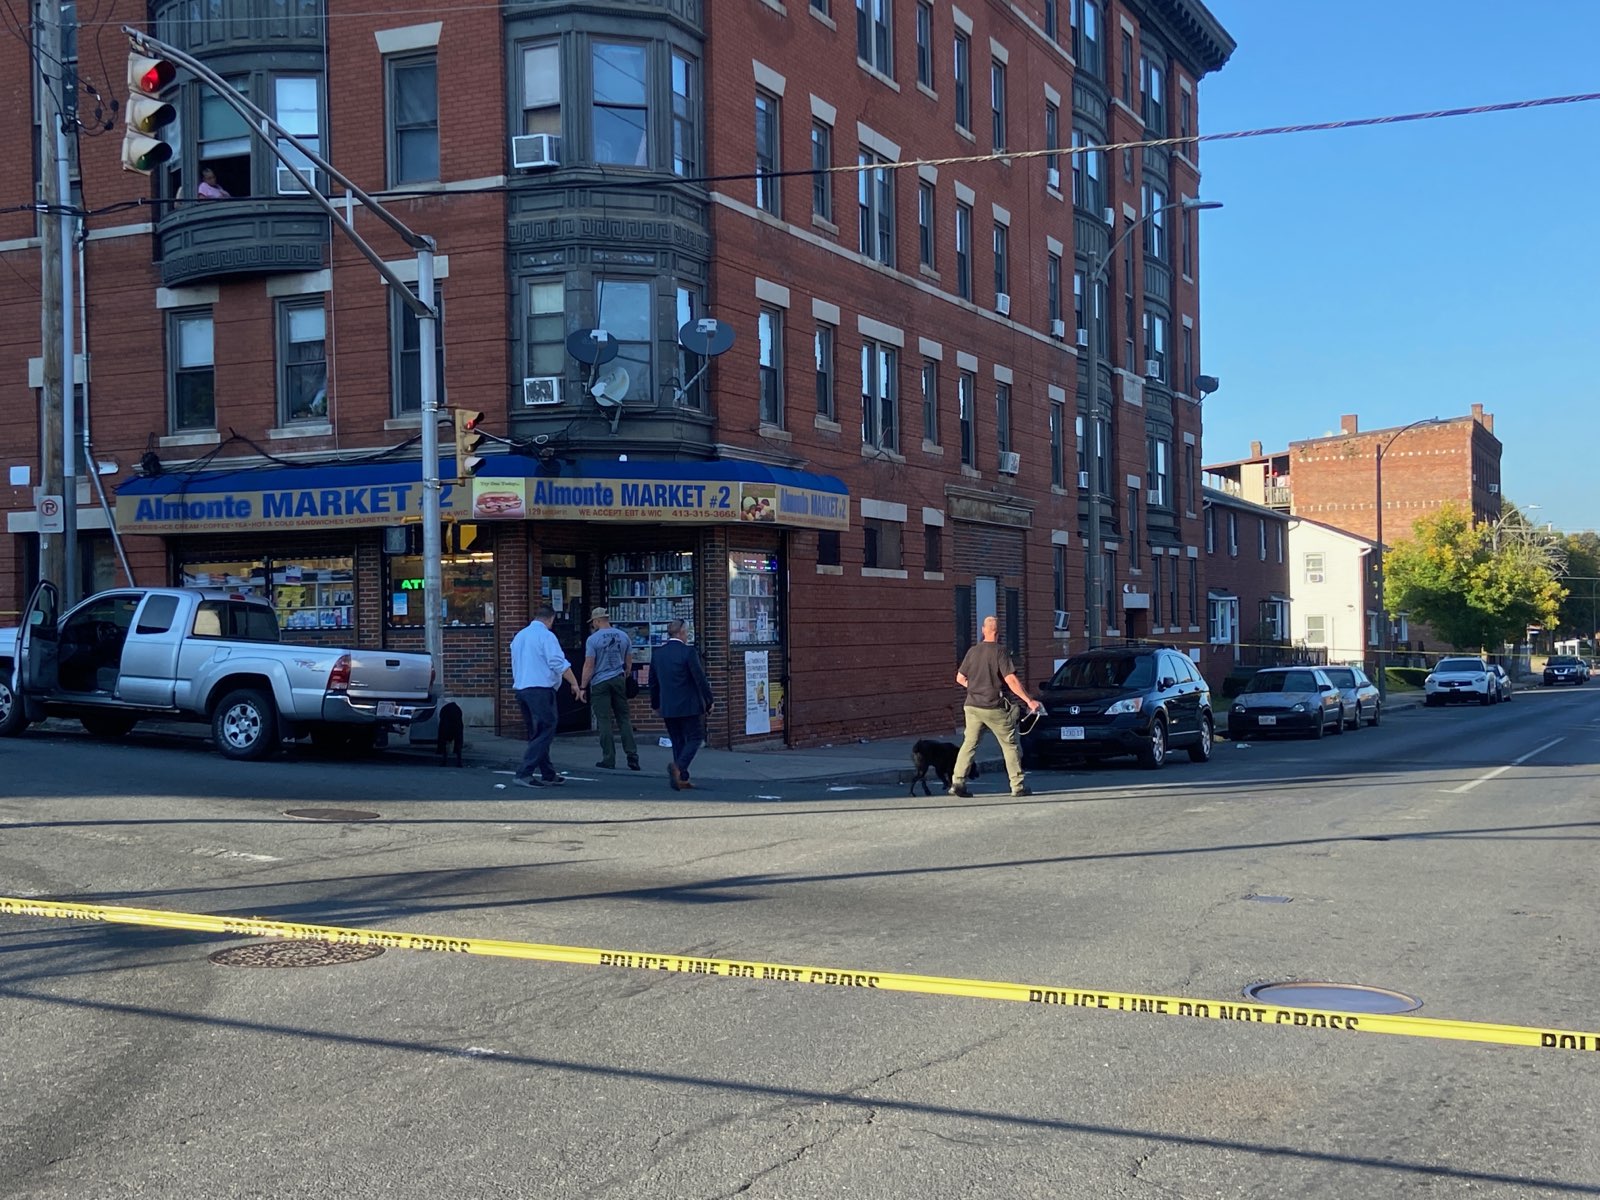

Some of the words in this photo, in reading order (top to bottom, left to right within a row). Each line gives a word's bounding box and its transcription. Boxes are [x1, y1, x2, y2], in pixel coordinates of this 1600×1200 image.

[533, 480, 614, 506] Almonte
[621, 483, 706, 508] MARKET
[709, 486, 731, 508] #2
[134, 495, 252, 522] Almonte
[262, 485, 412, 519] MARKET
[578, 508, 590, 516] WE
[624, 509, 639, 517] EBT
[251, 520, 265, 528] HOT
[274, 519, 294, 527] COLD
[296, 517, 344, 527] SANDWICHES
[401, 579, 424, 589] AT
[763, 966, 803, 982] NOT
